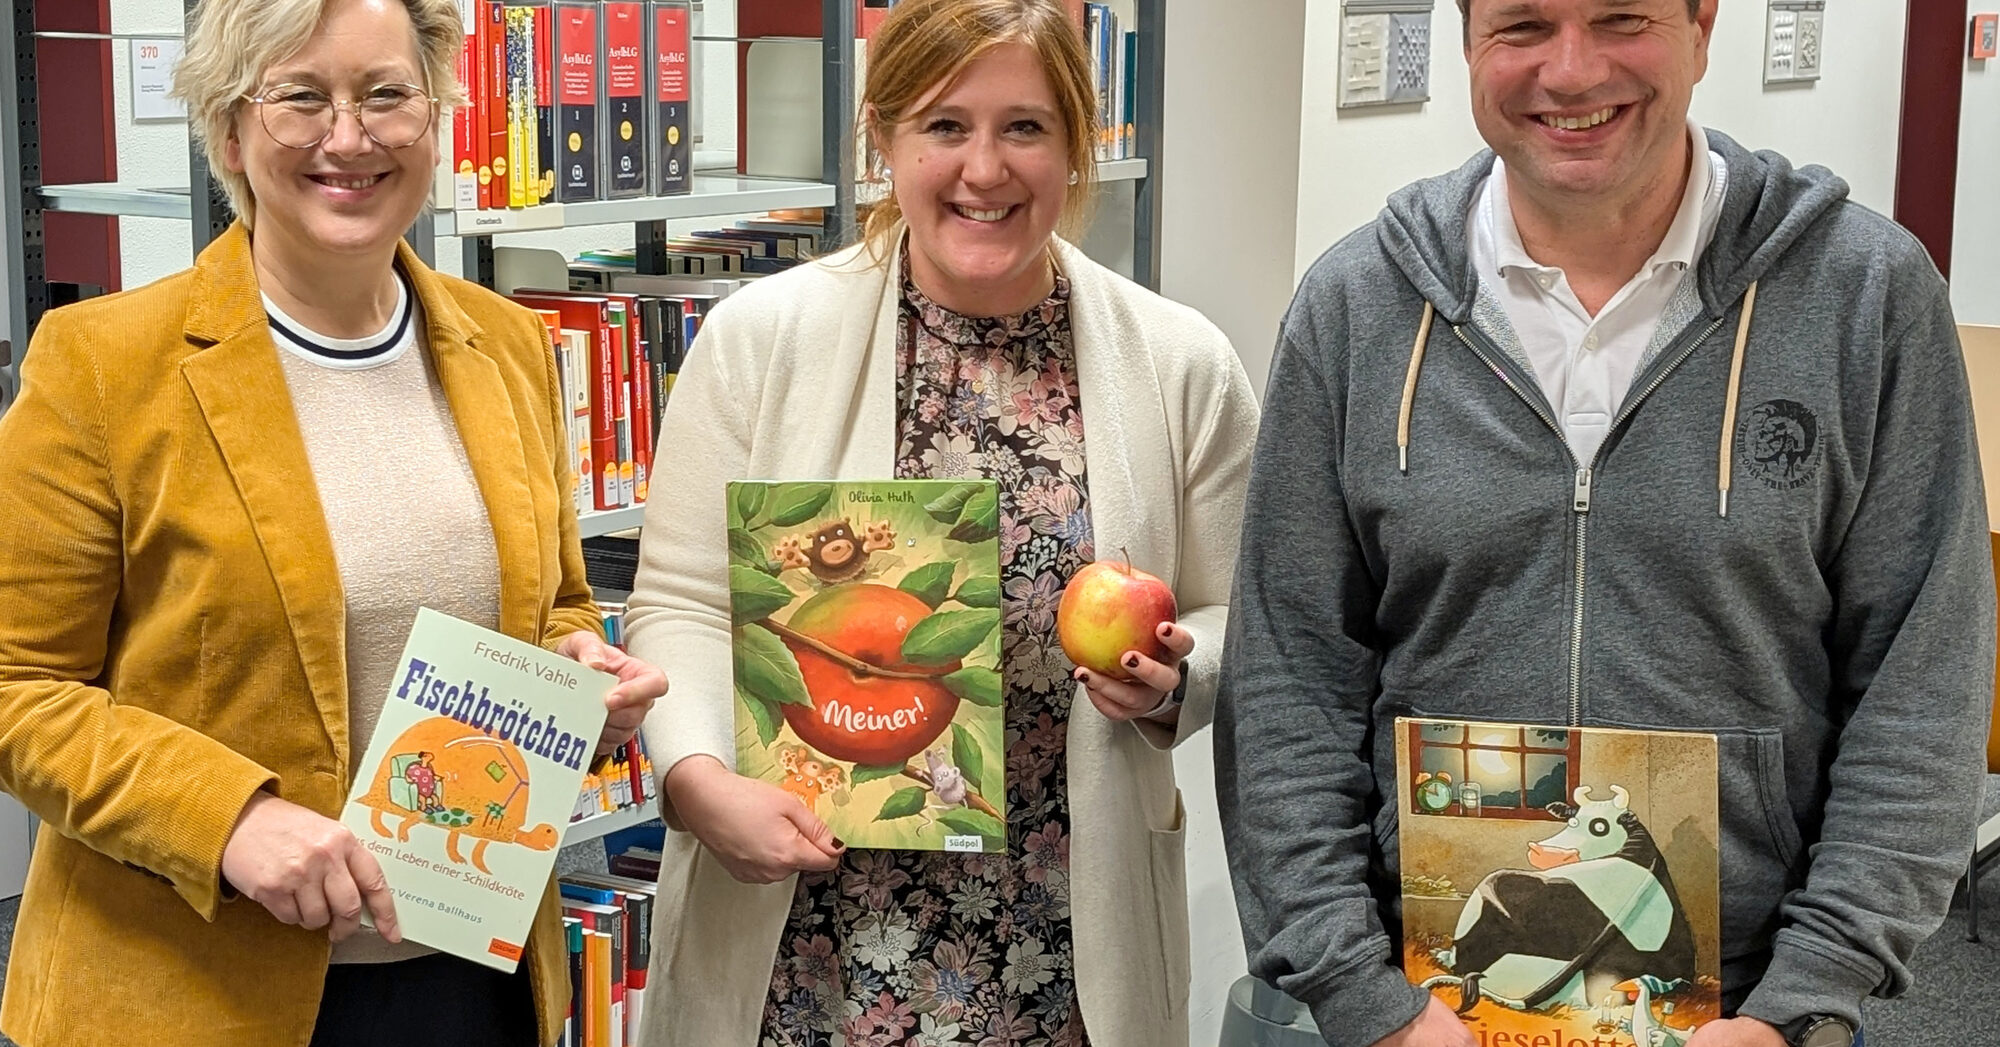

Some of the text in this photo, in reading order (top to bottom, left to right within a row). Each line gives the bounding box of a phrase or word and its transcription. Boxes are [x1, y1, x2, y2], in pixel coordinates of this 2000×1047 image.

[141, 46, 159, 59] 370
[621, 102, 628, 113] 2
[669, 107, 676, 118] 3
[574, 110, 580, 121] 1
[848, 490, 916, 504] Olivia Huth
[473, 641, 578, 690] Fredrik Vahle
[396, 658, 588, 771] Fischbrötchen
[822, 696, 929, 733] Meiner!
[949, 837, 979, 849] Südpol
[367, 839, 393, 856] dem
[395, 849, 430, 868] Leben
[432, 862, 461, 878] einer
[463, 872, 525, 901] Schildkröte
[397, 889, 436, 909] Verena
[437, 902, 483, 924] Ballhaus
